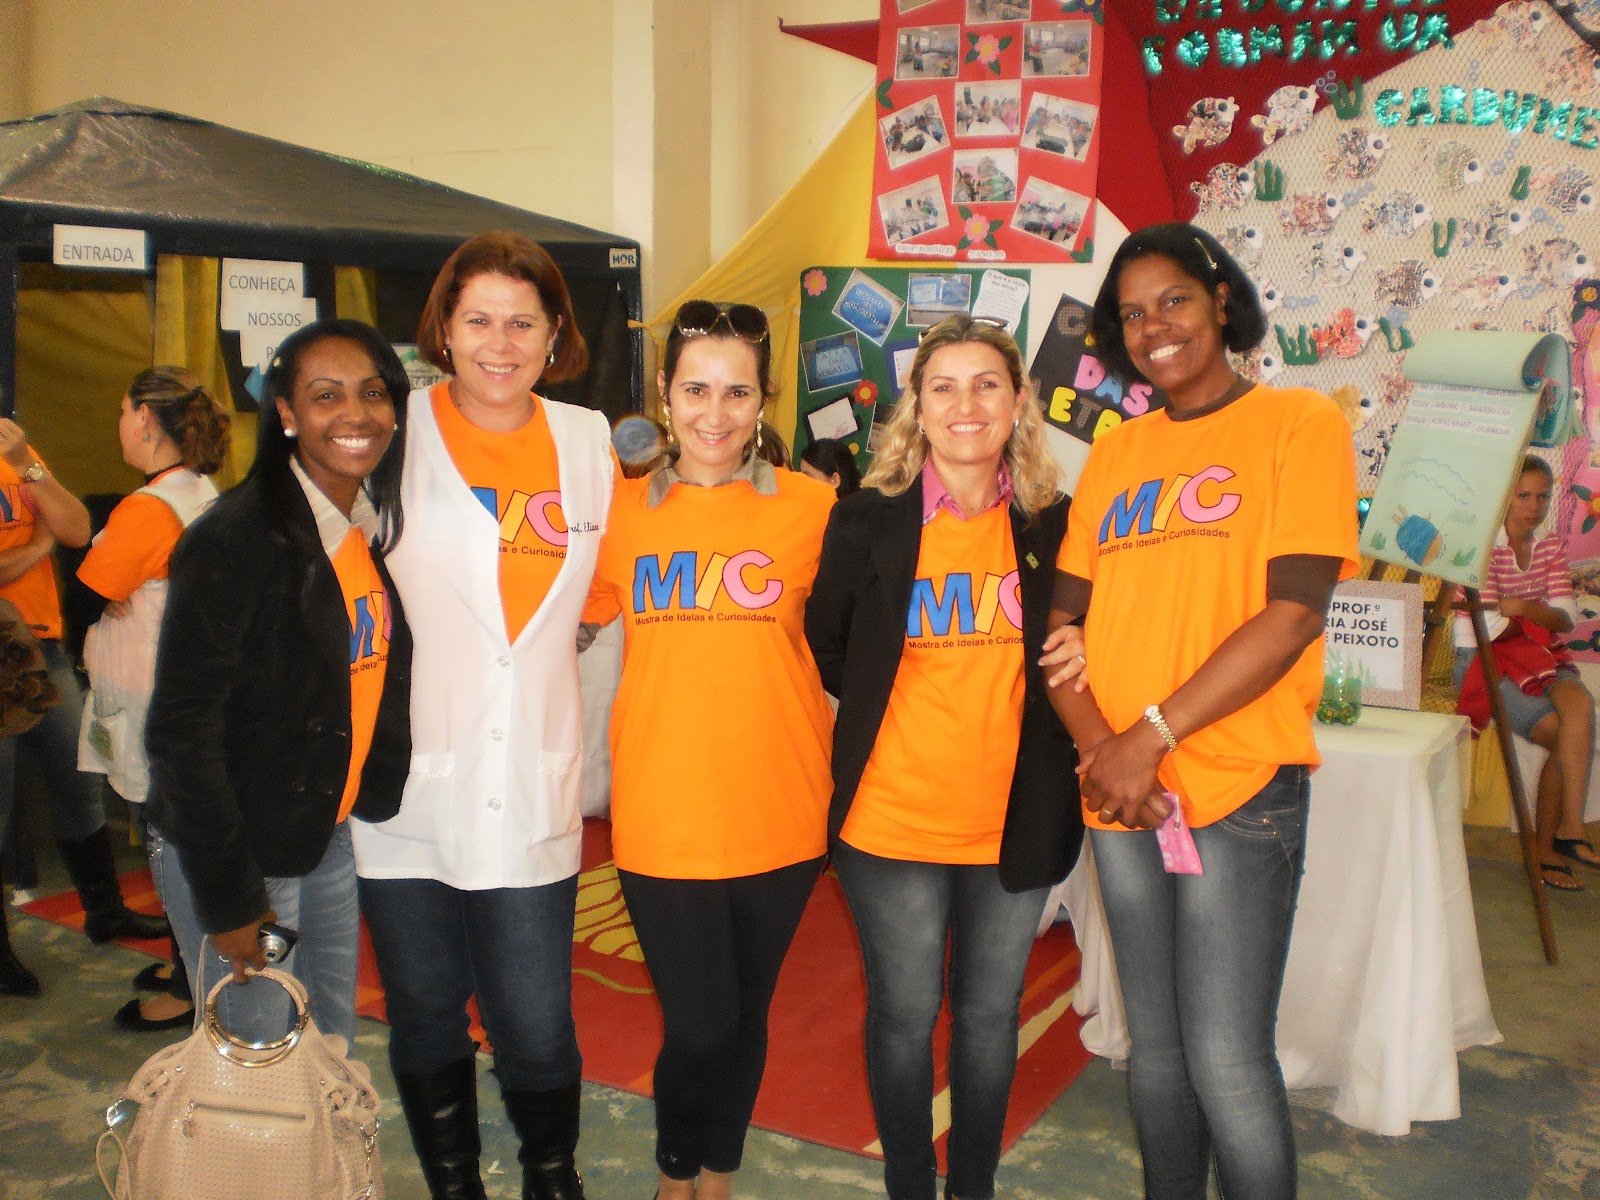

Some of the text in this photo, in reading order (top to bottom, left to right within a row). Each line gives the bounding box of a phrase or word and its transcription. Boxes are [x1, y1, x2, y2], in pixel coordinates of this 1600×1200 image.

[1373, 84, 1600, 149] CARDUME
[62, 244, 134, 263] ENTRADA
[229, 274, 296, 294] CONHEÇA
[247, 312, 301, 327] NOSSOS
[1074, 354, 1153, 416] DAS
[1098, 464, 1242, 546] MIC
[1122, 540, 1133, 550] de
[1136, 535, 1161, 548] Ideias
[1168, 527, 1231, 540] Curiosidades
[632, 549, 784, 614] MIC
[635, 616, 660, 626] Mostra
[662, 613, 674, 622] de
[677, 612, 705, 622] Ideias
[716, 612, 777, 624] Curiosidades
[1350, 617, 1388, 632] JOSÉ
[908, 640, 940, 649] Mostra
[942, 638, 955, 648] de
[957, 637, 985, 647] Ideias
[988, 637, 994, 645] e
[1333, 632, 1399, 648] PEIXOTO
